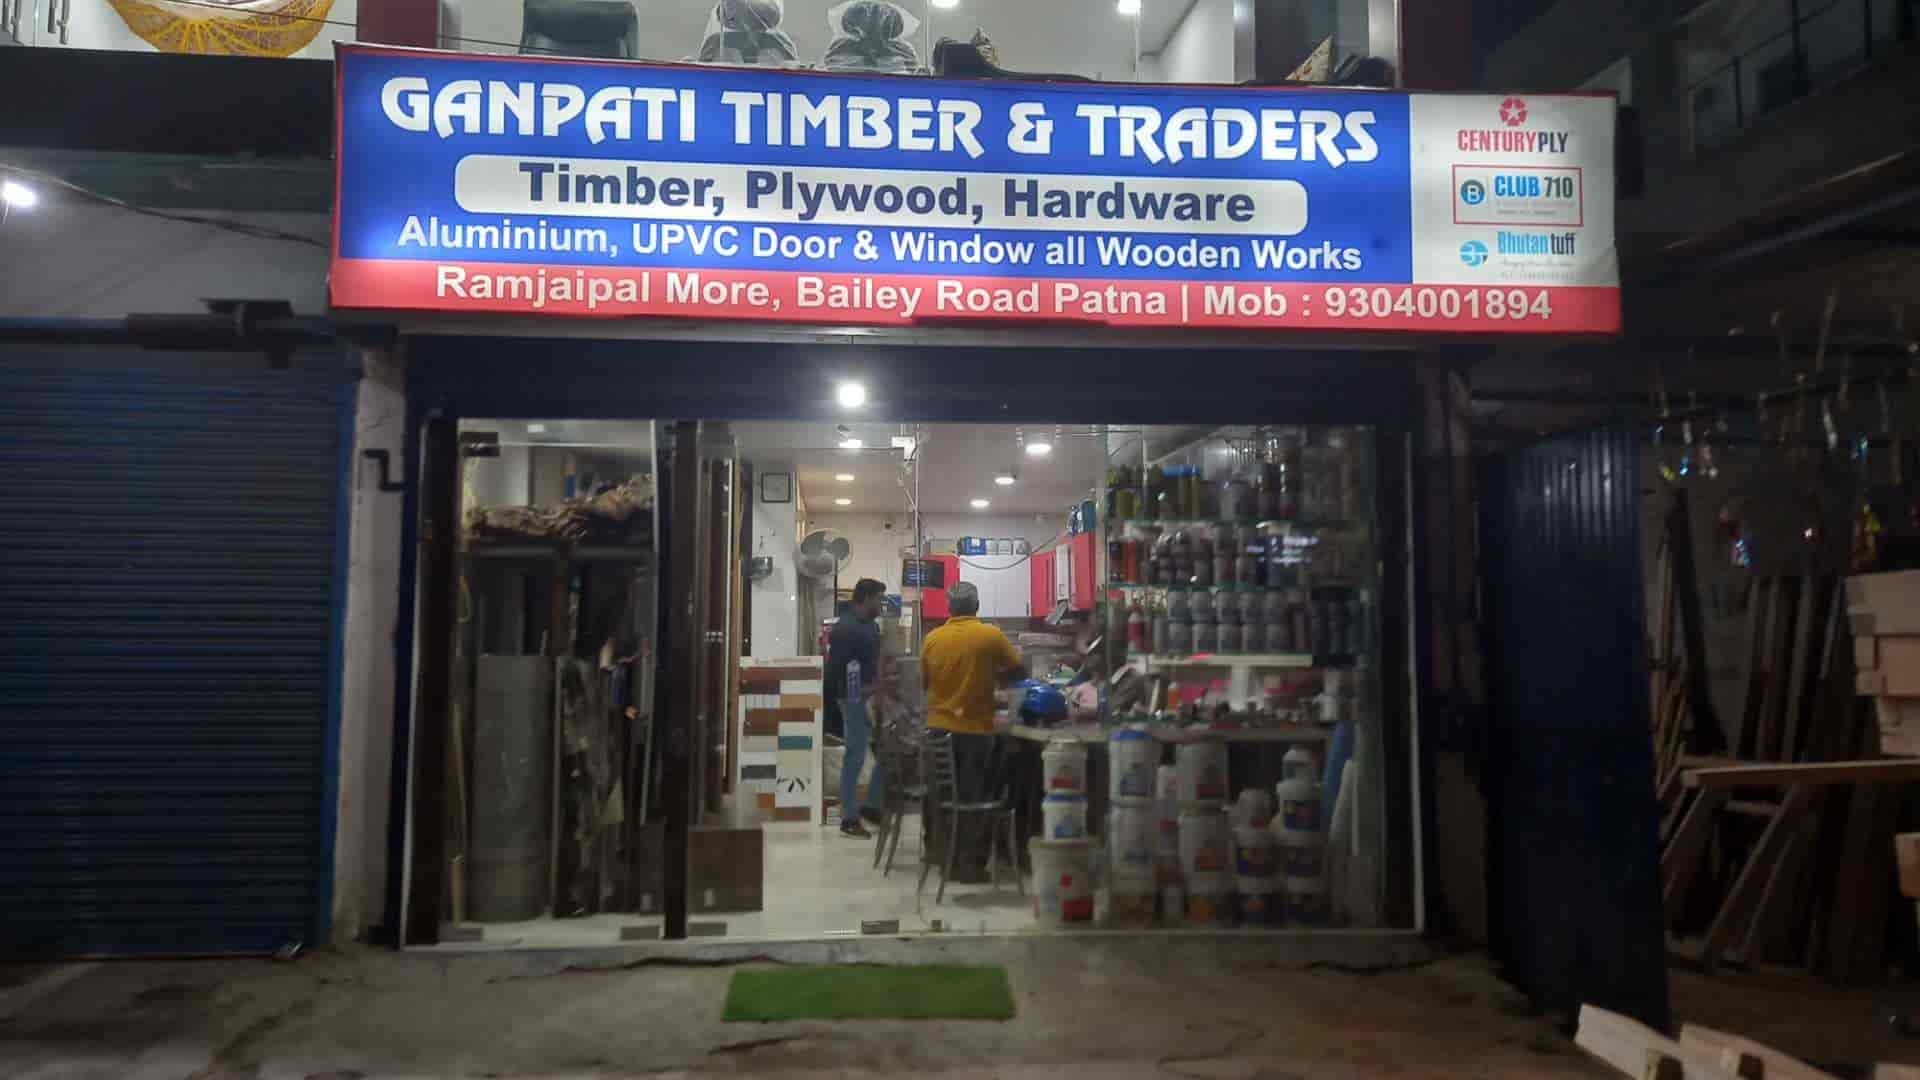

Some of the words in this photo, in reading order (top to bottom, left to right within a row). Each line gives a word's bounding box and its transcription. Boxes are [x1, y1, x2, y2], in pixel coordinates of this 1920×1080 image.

[381, 76, 696, 145] GANPATI
[721, 90, 983, 159] TIMBER
[1007, 102, 1053, 155] &
[1076, 104, 1379, 169] TRADERS
[1457, 130, 1568, 153] CENTURYPLY
[519, 162, 724, 216] Timber,
[746, 171, 984, 225] Plywood,
[1004, 179, 1255, 223] Hardware
[1494, 175, 1540, 198] CLUB
[1544, 177, 1574, 199] 710
[398, 215, 618, 258] Aluminium,
[632, 222, 739, 257] UPVC
[753, 226, 841, 260] Door
[853, 230, 878, 262] &
[891, 231, 1034, 265] Window
[1046, 236, 1085, 266] all
[1096, 236, 1240, 270] Wooden
[1251, 239, 1362, 271] Works
[437, 266, 650, 309] Ramjaipal
[666, 273, 781, 311] More,
[797, 276, 922, 318] Bailey
[936, 279, 1040, 313] Road
[1054, 284, 1166, 316] Patna
[1204, 287, 1287, 318] Mob
[1325, 287, 1552, 320] 9304001894
